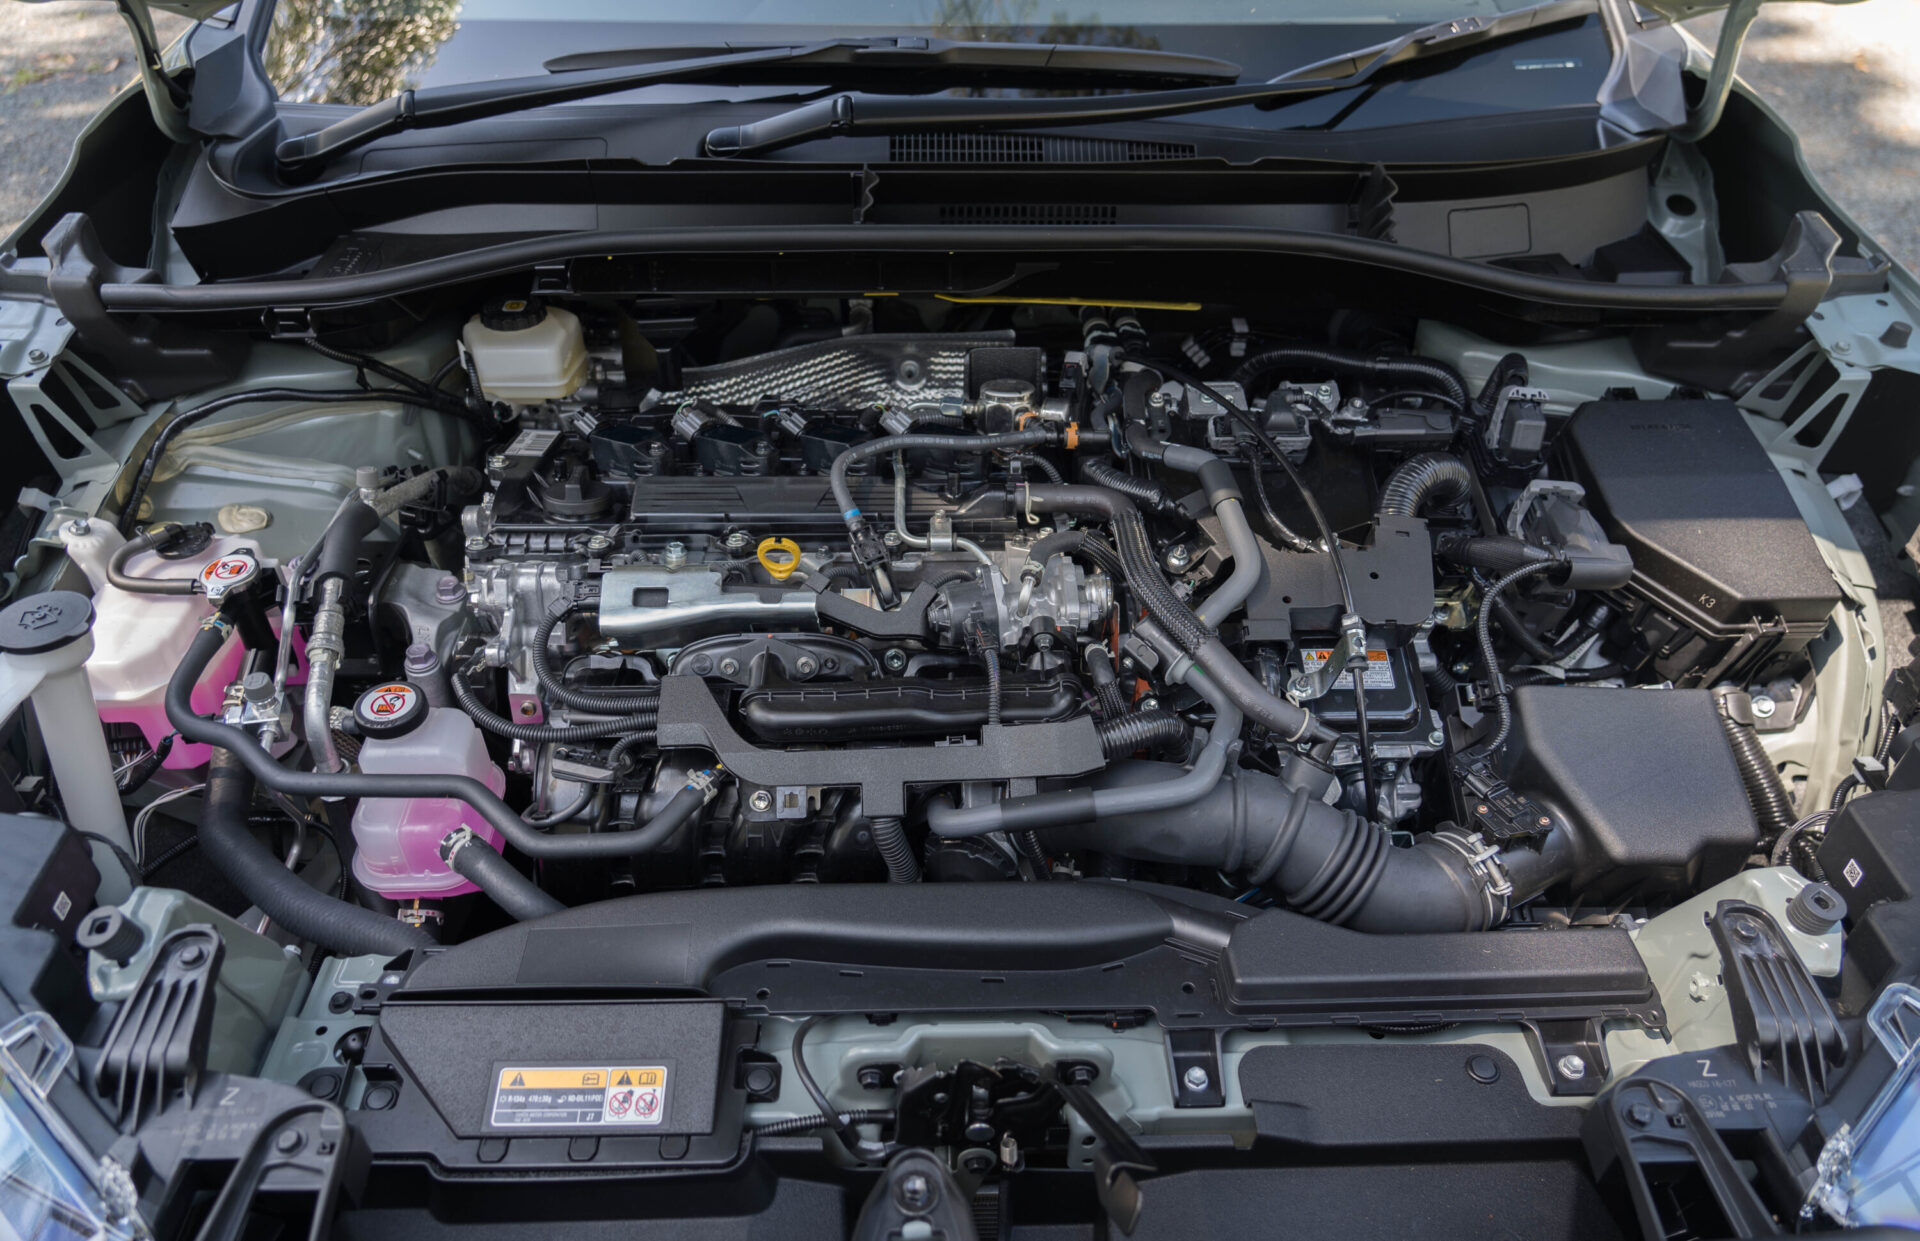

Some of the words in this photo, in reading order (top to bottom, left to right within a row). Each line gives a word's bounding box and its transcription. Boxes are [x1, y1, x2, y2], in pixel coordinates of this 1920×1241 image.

[1698, 593, 1716, 608] K3
[745, 823, 785, 848] HV
[1697, 1059, 1718, 1077] Z
[219, 1086, 240, 1106] Z
